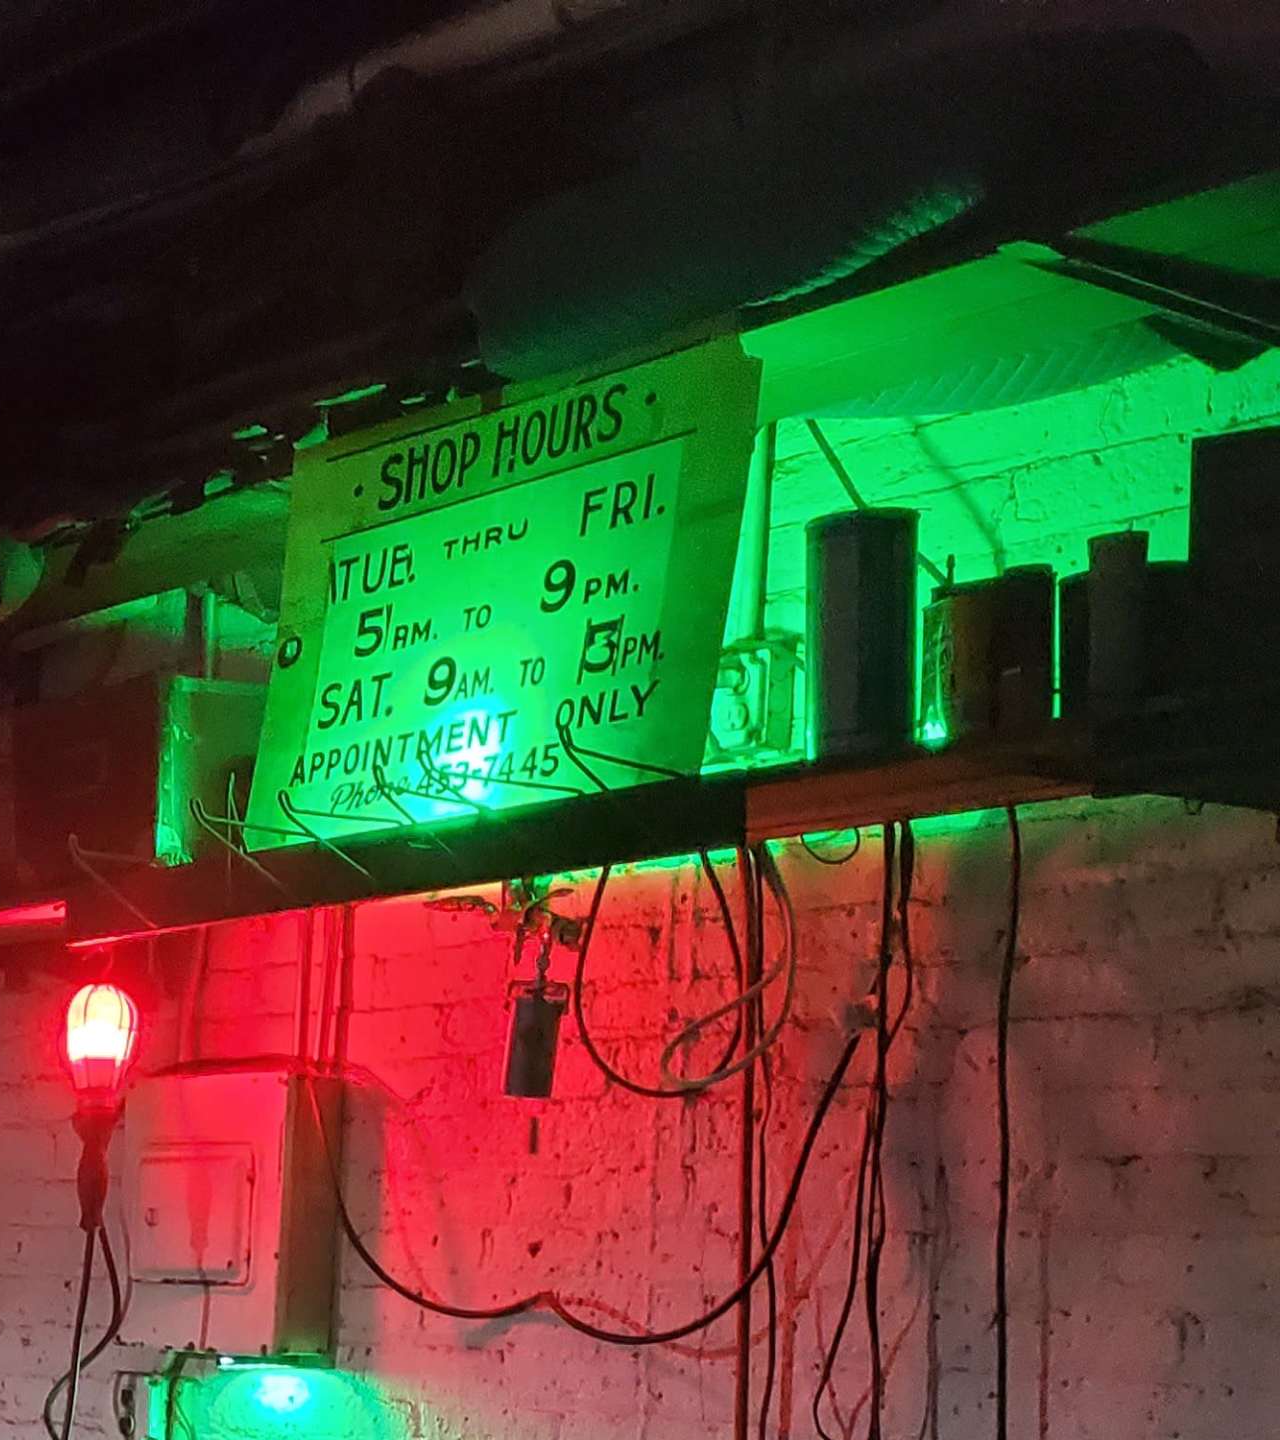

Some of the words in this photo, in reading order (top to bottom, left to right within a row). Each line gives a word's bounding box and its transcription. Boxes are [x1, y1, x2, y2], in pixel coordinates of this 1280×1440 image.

[378, 430, 481, 511] SHOP
[492, 383, 628, 477] HOURS
[444, 518, 529, 559] THRU
[579, 473, 666, 537] FRI.
[463, 604, 492, 632] TO
[540, 559, 576, 613] 9
[583, 569, 640, 604] PM.
[317, 672, 394, 730] SAT.
[424, 656, 457, 706] 9
[454, 666, 495, 701] AM.
[520, 656, 546, 688] TO
[621, 629, 665, 669] PM.
[288, 709, 518, 788] APPOINTMENT
[555, 679, 660, 732] ONLY
